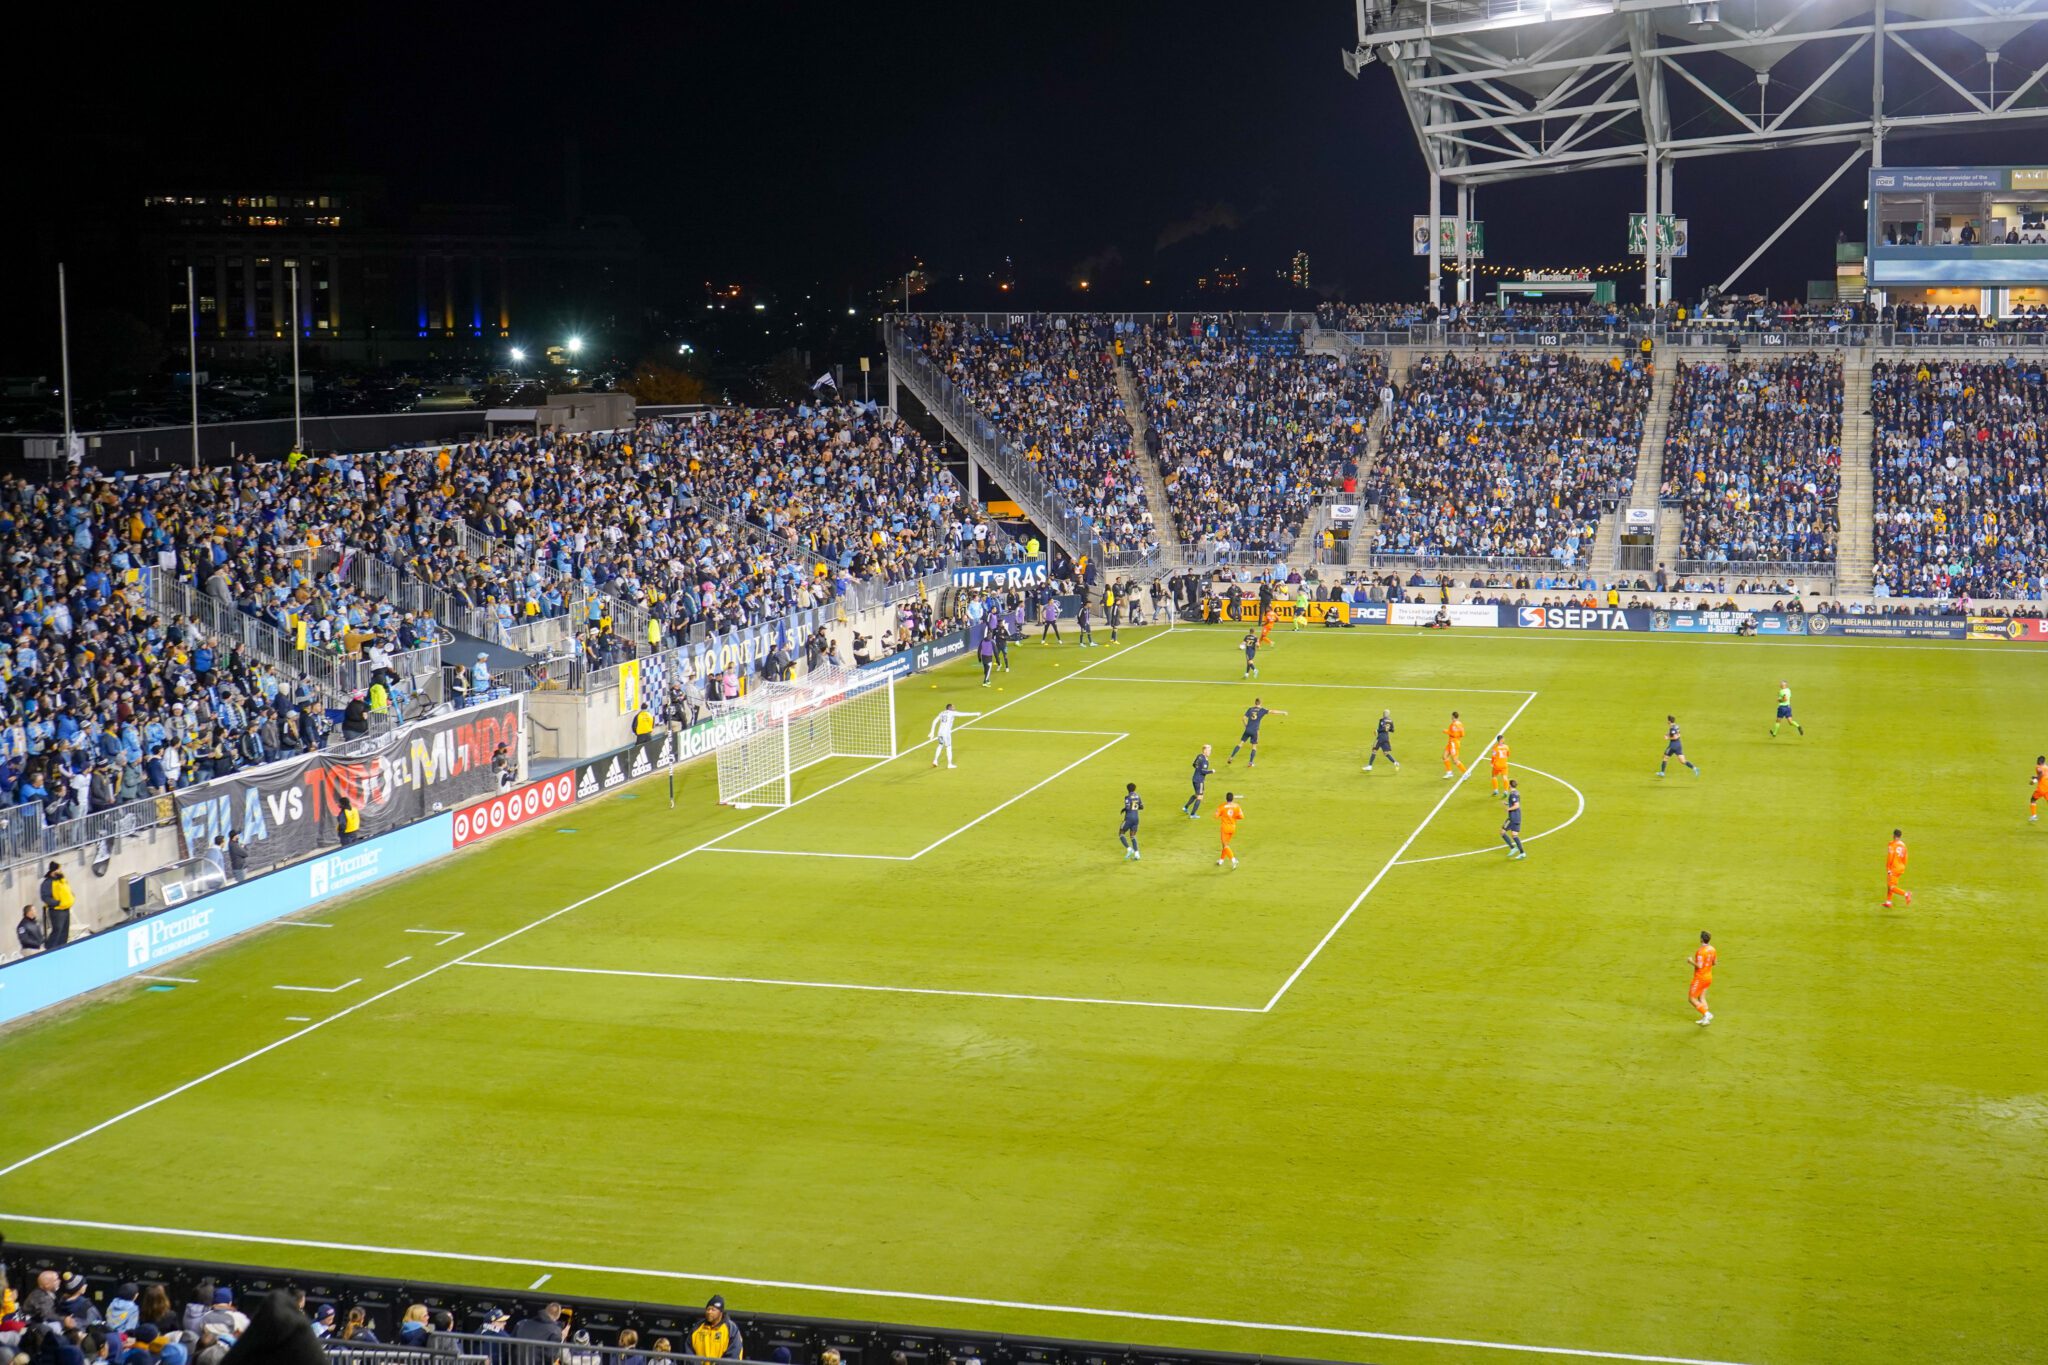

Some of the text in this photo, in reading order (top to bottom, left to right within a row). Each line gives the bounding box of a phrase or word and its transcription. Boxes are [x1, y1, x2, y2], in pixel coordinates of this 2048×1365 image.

[1010, 315, 1024, 325] 101
[1539, 335, 1557, 346] 103
[1763, 334, 1781, 345] 104
[1548, 608, 1629, 630] SEPTA
[1829, 617, 1871, 626] PHILADELPHIA
[1872, 618, 1892, 627] UNION
[1924, 620, 1933, 628] ON
[1934, 620, 1949, 628] SALE
[1951, 621, 1965, 629] NOW
[694, 649, 716, 679] NO
[720, 640, 750, 672] ONE
[754, 628, 795, 659] LIKS
[932, 646, 947, 658] Please
[411, 712, 518, 791] MUNDO
[631, 763, 652, 778] adidas
[604, 773, 625, 788] adidas
[577, 783, 599, 799] adidas
[330, 848, 383, 879] Premier
[151, 908, 214, 946] Premier
